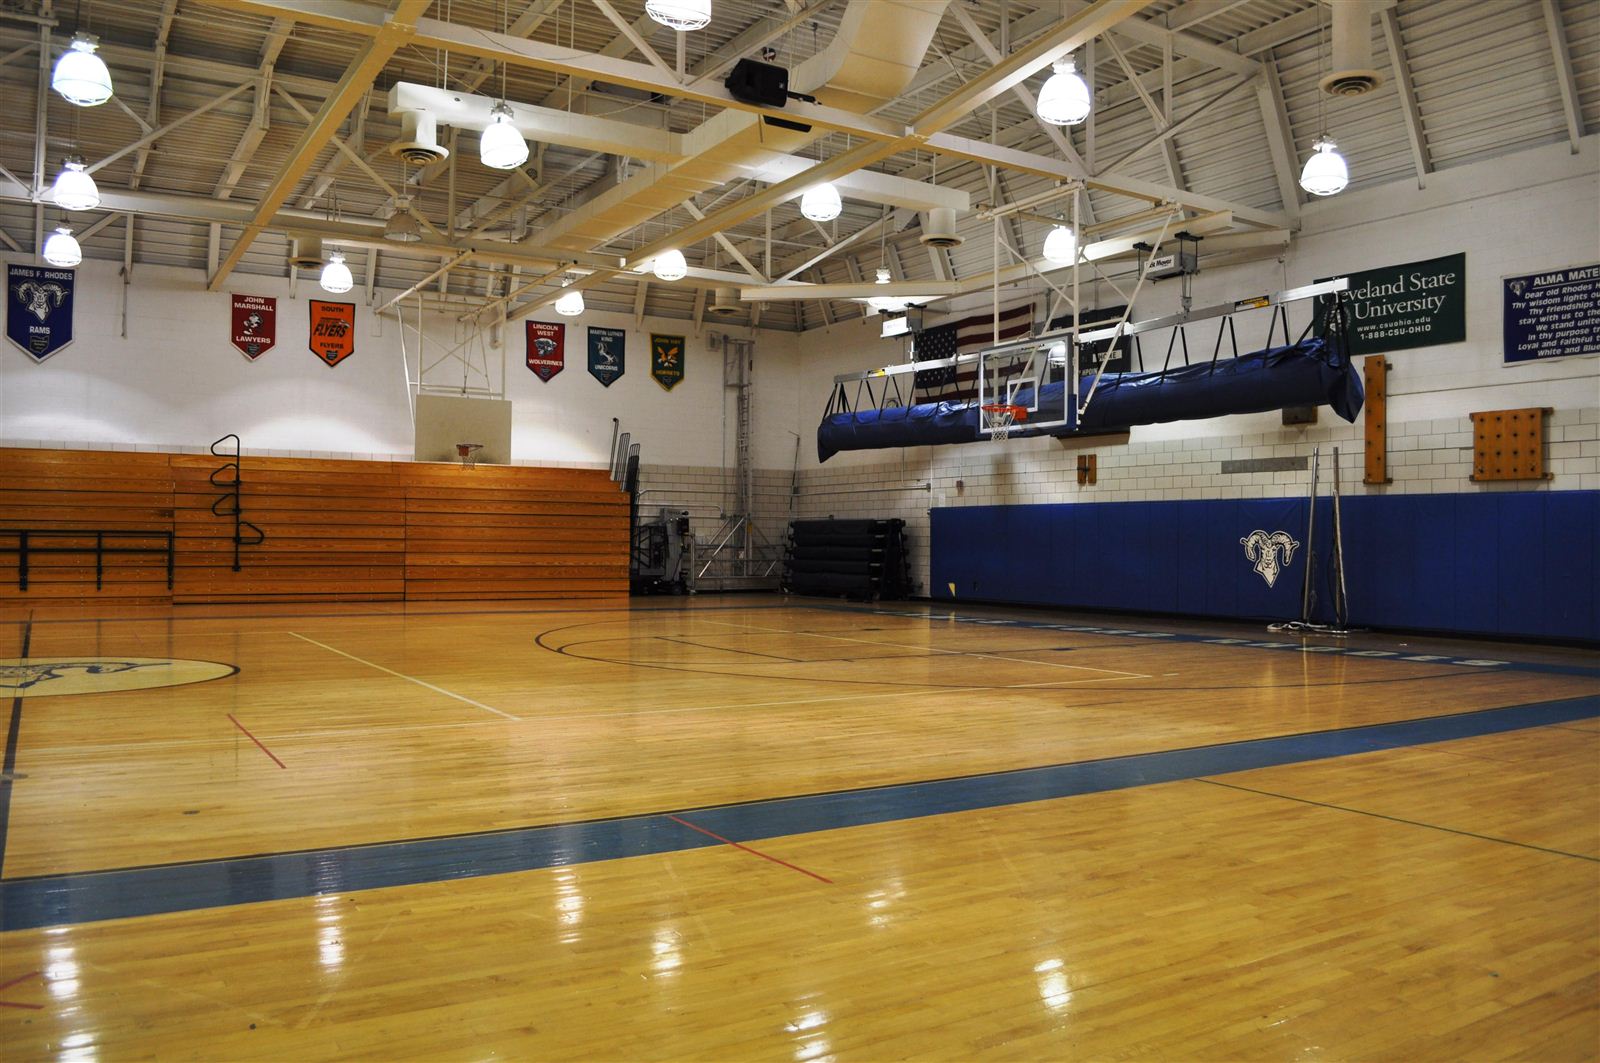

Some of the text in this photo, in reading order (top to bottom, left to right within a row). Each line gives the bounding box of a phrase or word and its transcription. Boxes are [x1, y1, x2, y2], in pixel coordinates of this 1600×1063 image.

[10, 268, 34, 277] JAMES
[44, 271, 72, 280] RHODES
[1534, 268, 1600, 286] ALMA MATE
[1409, 272, 1456, 292] State
[1524, 290, 1544, 299] Dear
[1546, 288, 1560, 296] old
[1562, 283, 1592, 294] Rhodes
[244, 296, 265, 304] JOHN
[1354, 292, 1447, 320] University
[1512, 302, 1526, 310] Thy
[1530, 297, 1560, 307] wisdom
[1563, 292, 1588, 302] lights
[234, 302, 274, 312] MARSHALL
[1529, 308, 1544, 316] Thy
[1546, 300, 1594, 313] friendships
[1357, 316, 1431, 332] www.csuohio.edu
[1518, 317, 1536, 326] stay
[1540, 314, 1559, 322] with
[1536, 324, 1548, 332] We
[1551, 320, 1574, 330] stand
[30, 326, 50, 334] RAMS
[314, 322, 347, 338] FLYERS
[1360, 324, 1432, 340] 1-888-CSU-OHIO
[1540, 332, 1552, 340] thy
[1556, 328, 1590, 338] purpose
[236, 336, 271, 344] LAWYERS
[320, 342, 344, 350] FLYERS
[1518, 342, 1538, 351] Loyal
[1542, 340, 1557, 348] and
[1564, 346, 1580, 354] and
[528, 359, 563, 367] WOLVERINES
